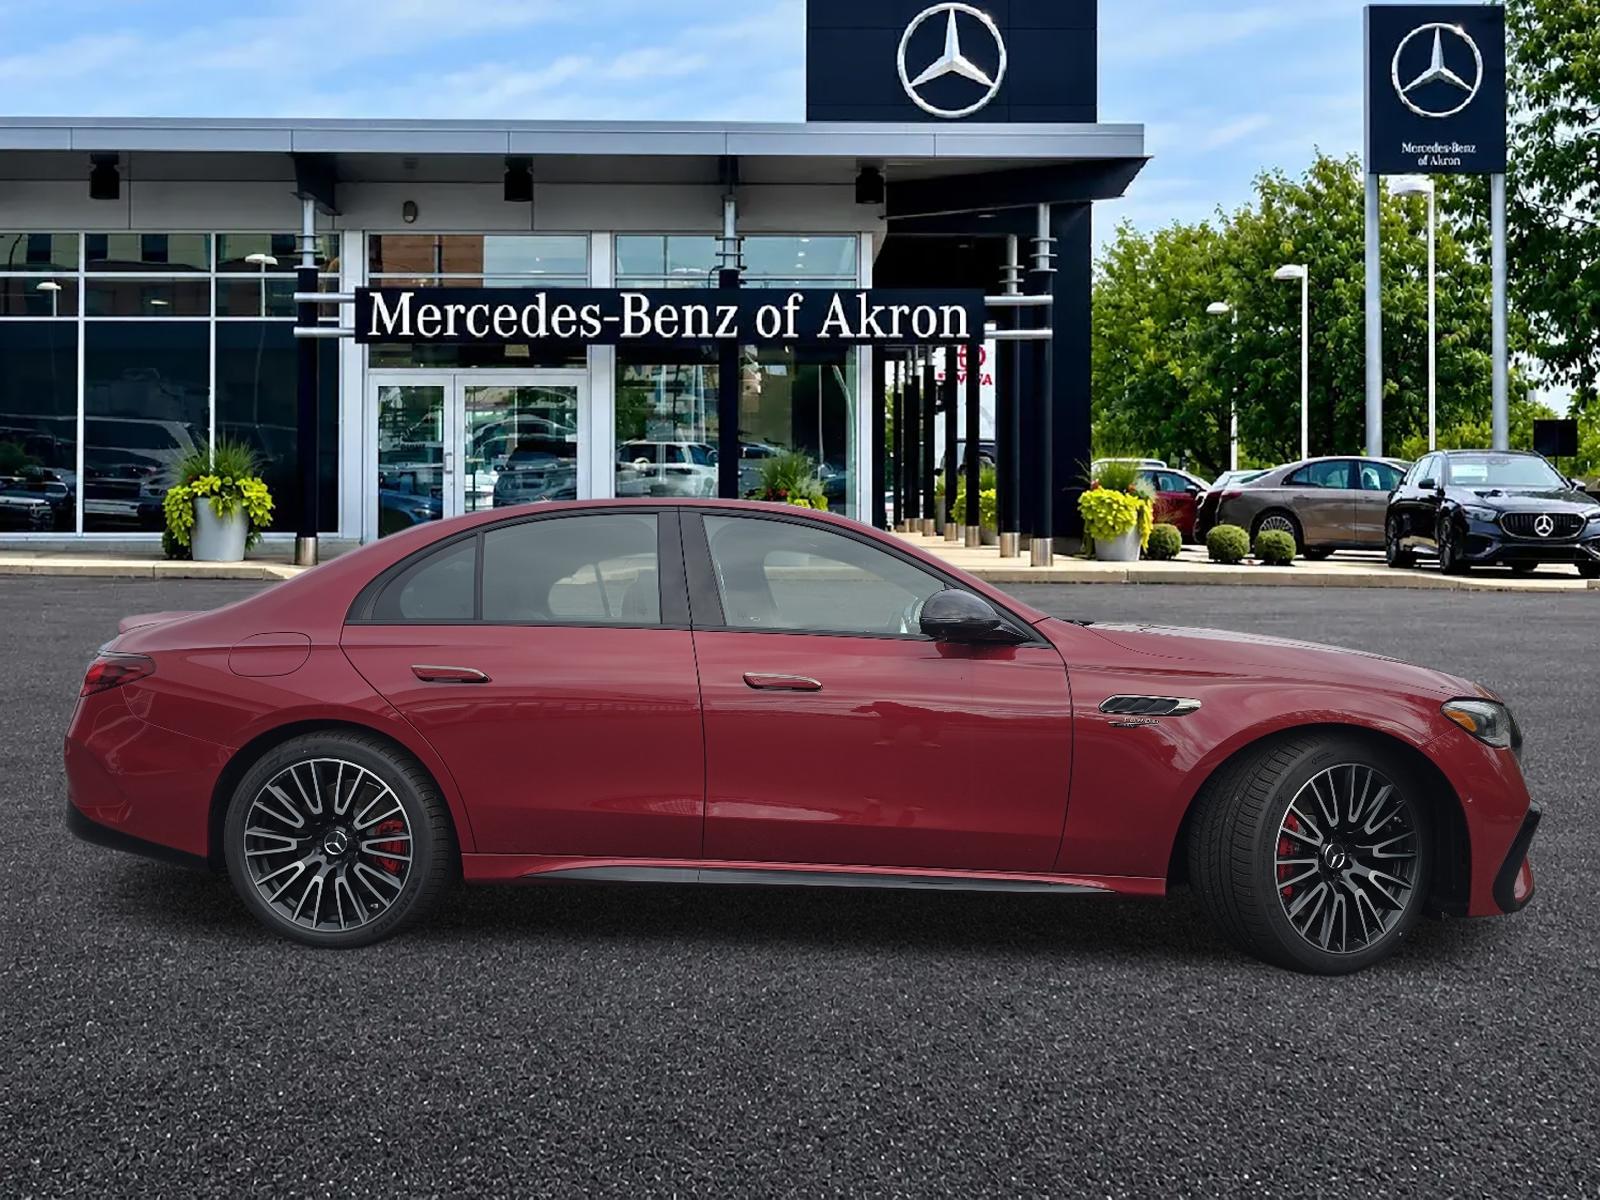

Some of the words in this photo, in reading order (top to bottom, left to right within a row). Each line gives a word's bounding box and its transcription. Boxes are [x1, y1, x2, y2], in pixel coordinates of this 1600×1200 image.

[1401, 142, 1477, 154] Mercedes-Benz
[1417, 154, 1429, 166] of
[1430, 154, 1461, 166] Akron
[367, 291, 738, 338] Mercedes-Benz
[755, 291, 804, 338] of
[816, 291, 971, 338] Akron
